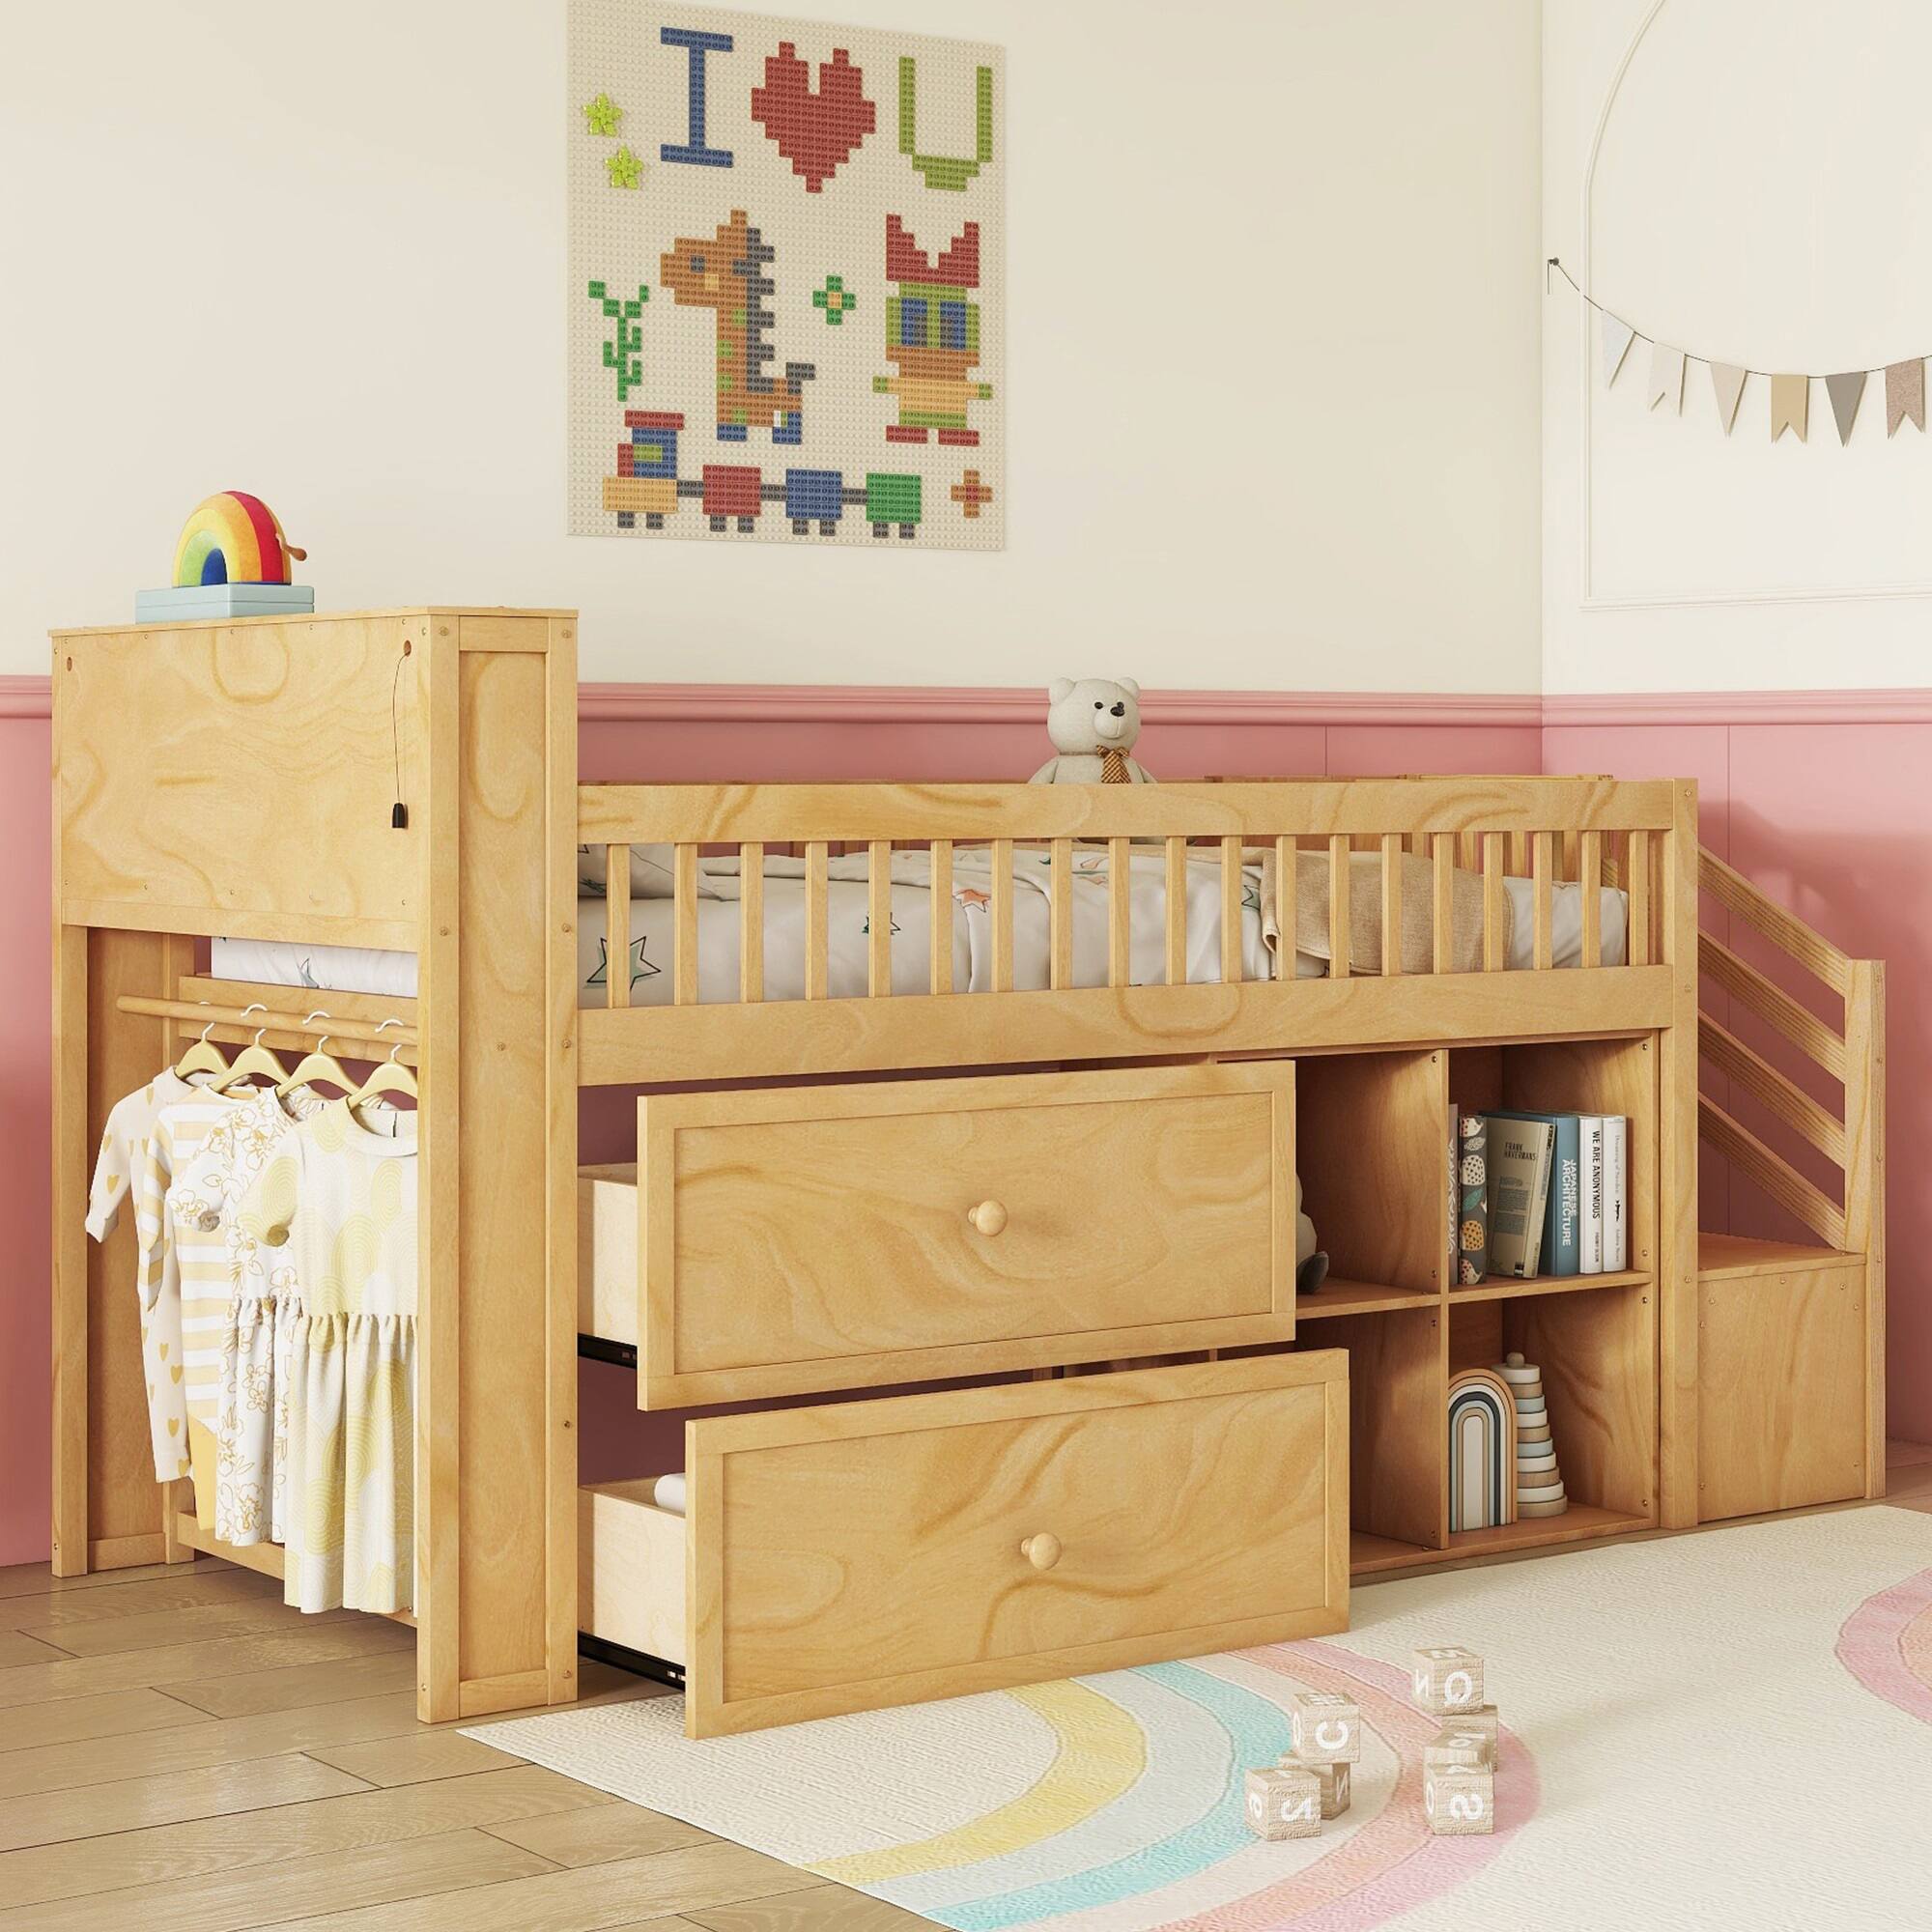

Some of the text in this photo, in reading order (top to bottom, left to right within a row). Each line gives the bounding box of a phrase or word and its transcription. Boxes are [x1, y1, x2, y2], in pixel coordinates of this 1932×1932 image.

[660, 26, 992, 191] I U
[1562, 1158, 1572, 1246] ARCHITECTURE
[1592, 1130, 1601, 1219] WE ARE ANONYMOUS
[1315, 1720, 1349, 1750] C
